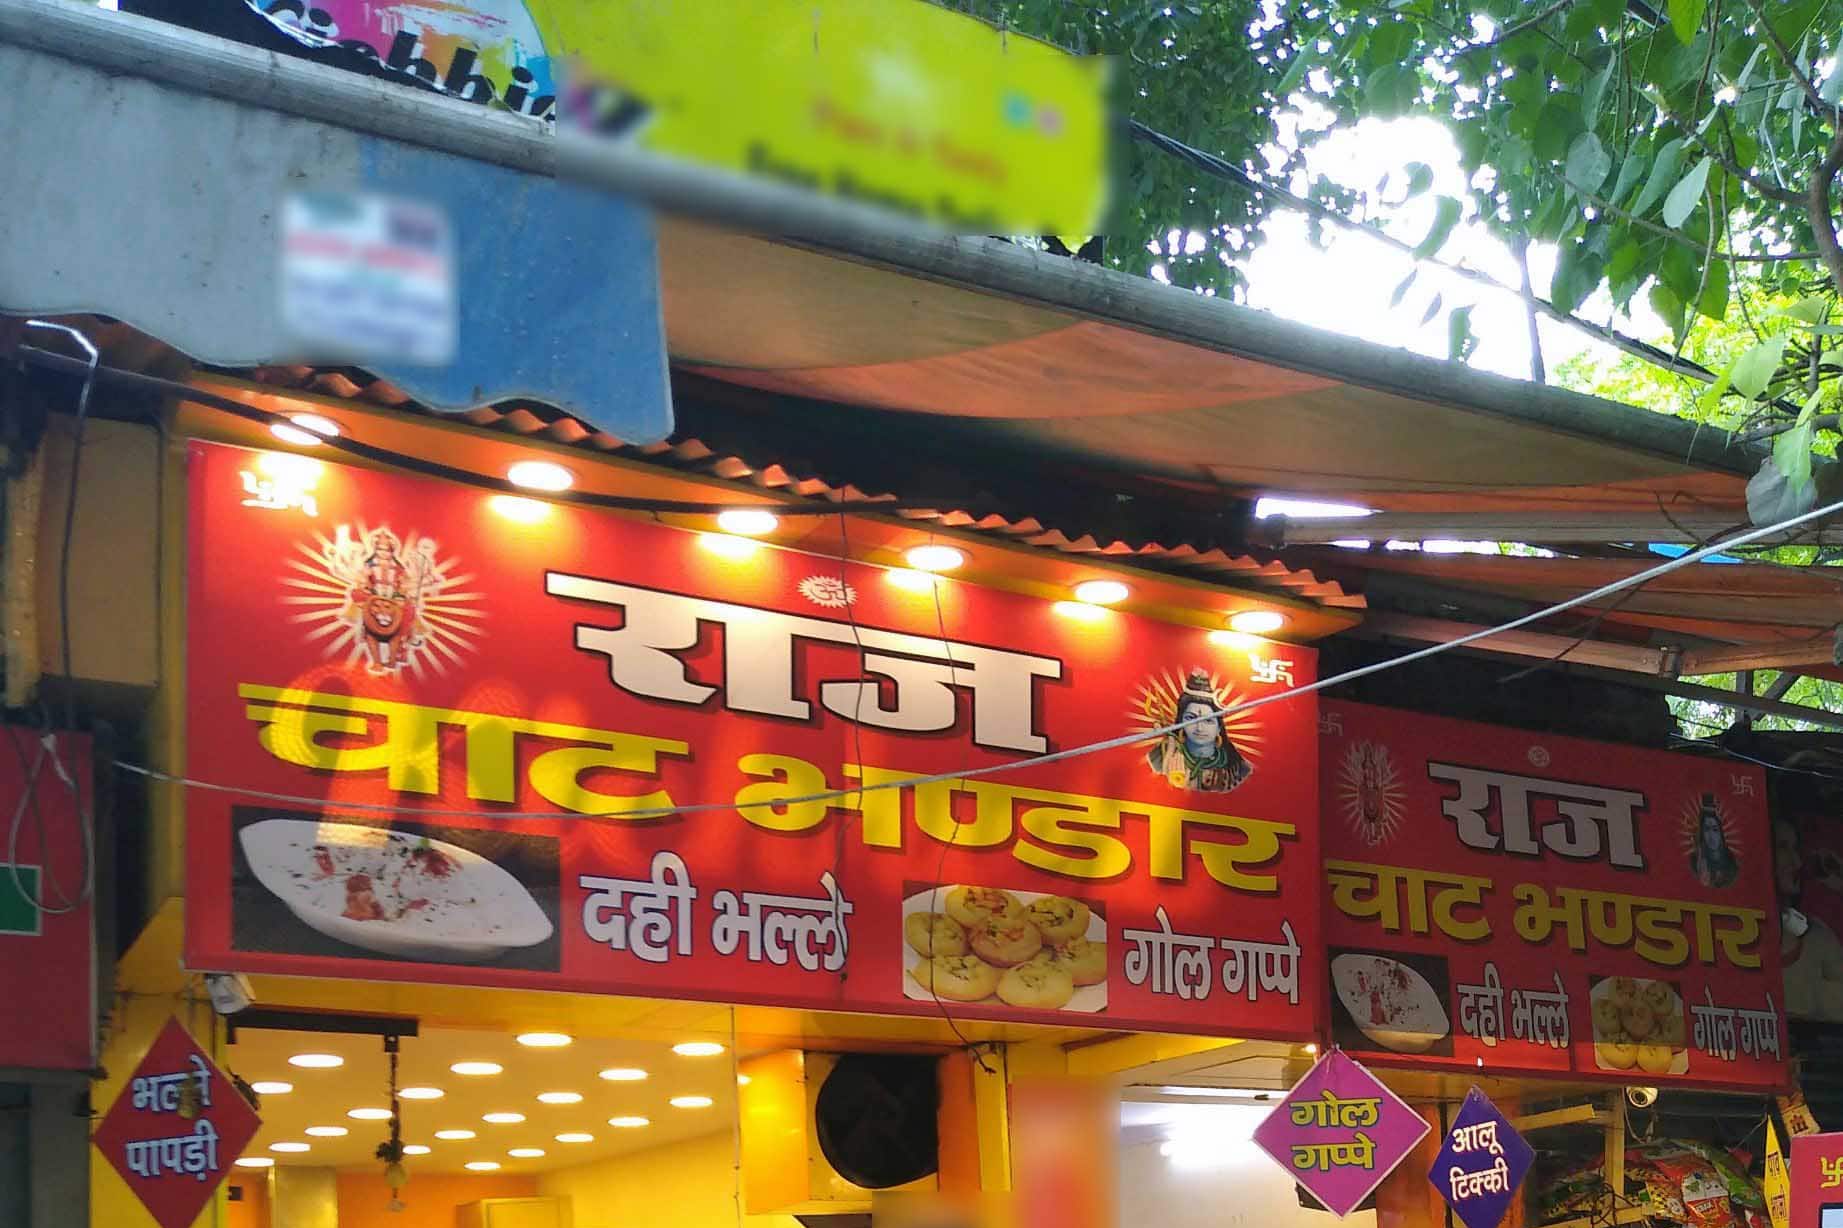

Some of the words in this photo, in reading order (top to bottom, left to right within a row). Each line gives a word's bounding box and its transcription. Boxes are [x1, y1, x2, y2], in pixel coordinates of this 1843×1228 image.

[545, 570, 1062, 755] राज
[238, 683, 689, 820] चाट
[734, 752, 1296, 891] भण्डार
[1427, 760, 1647, 870] राज
[579, 850, 697, 963] दही
[712, 871, 853, 973] भल्ले
[1122, 906, 1217, 1000] गोल
[1220, 920, 1302, 1005] गप्पे
[1325, 859, 1493, 941] चाट
[1512, 883, 1767, 968] भण्डार
[1456, 960, 1505, 1047] दही
[1511, 971, 1570, 1048] भल्ले
[1689, 985, 1737, 1061] गोल
[1741, 993, 1782, 1061] गप्पे
[125, 1118, 221, 1181] पापड़ी
[1289, 1088, 1383, 1128] गोल
[1290, 1131, 1377, 1172] गप्पे
[1452, 1120, 1504, 1155] आलू
[1449, 1157, 1511, 1200] टिक्की
